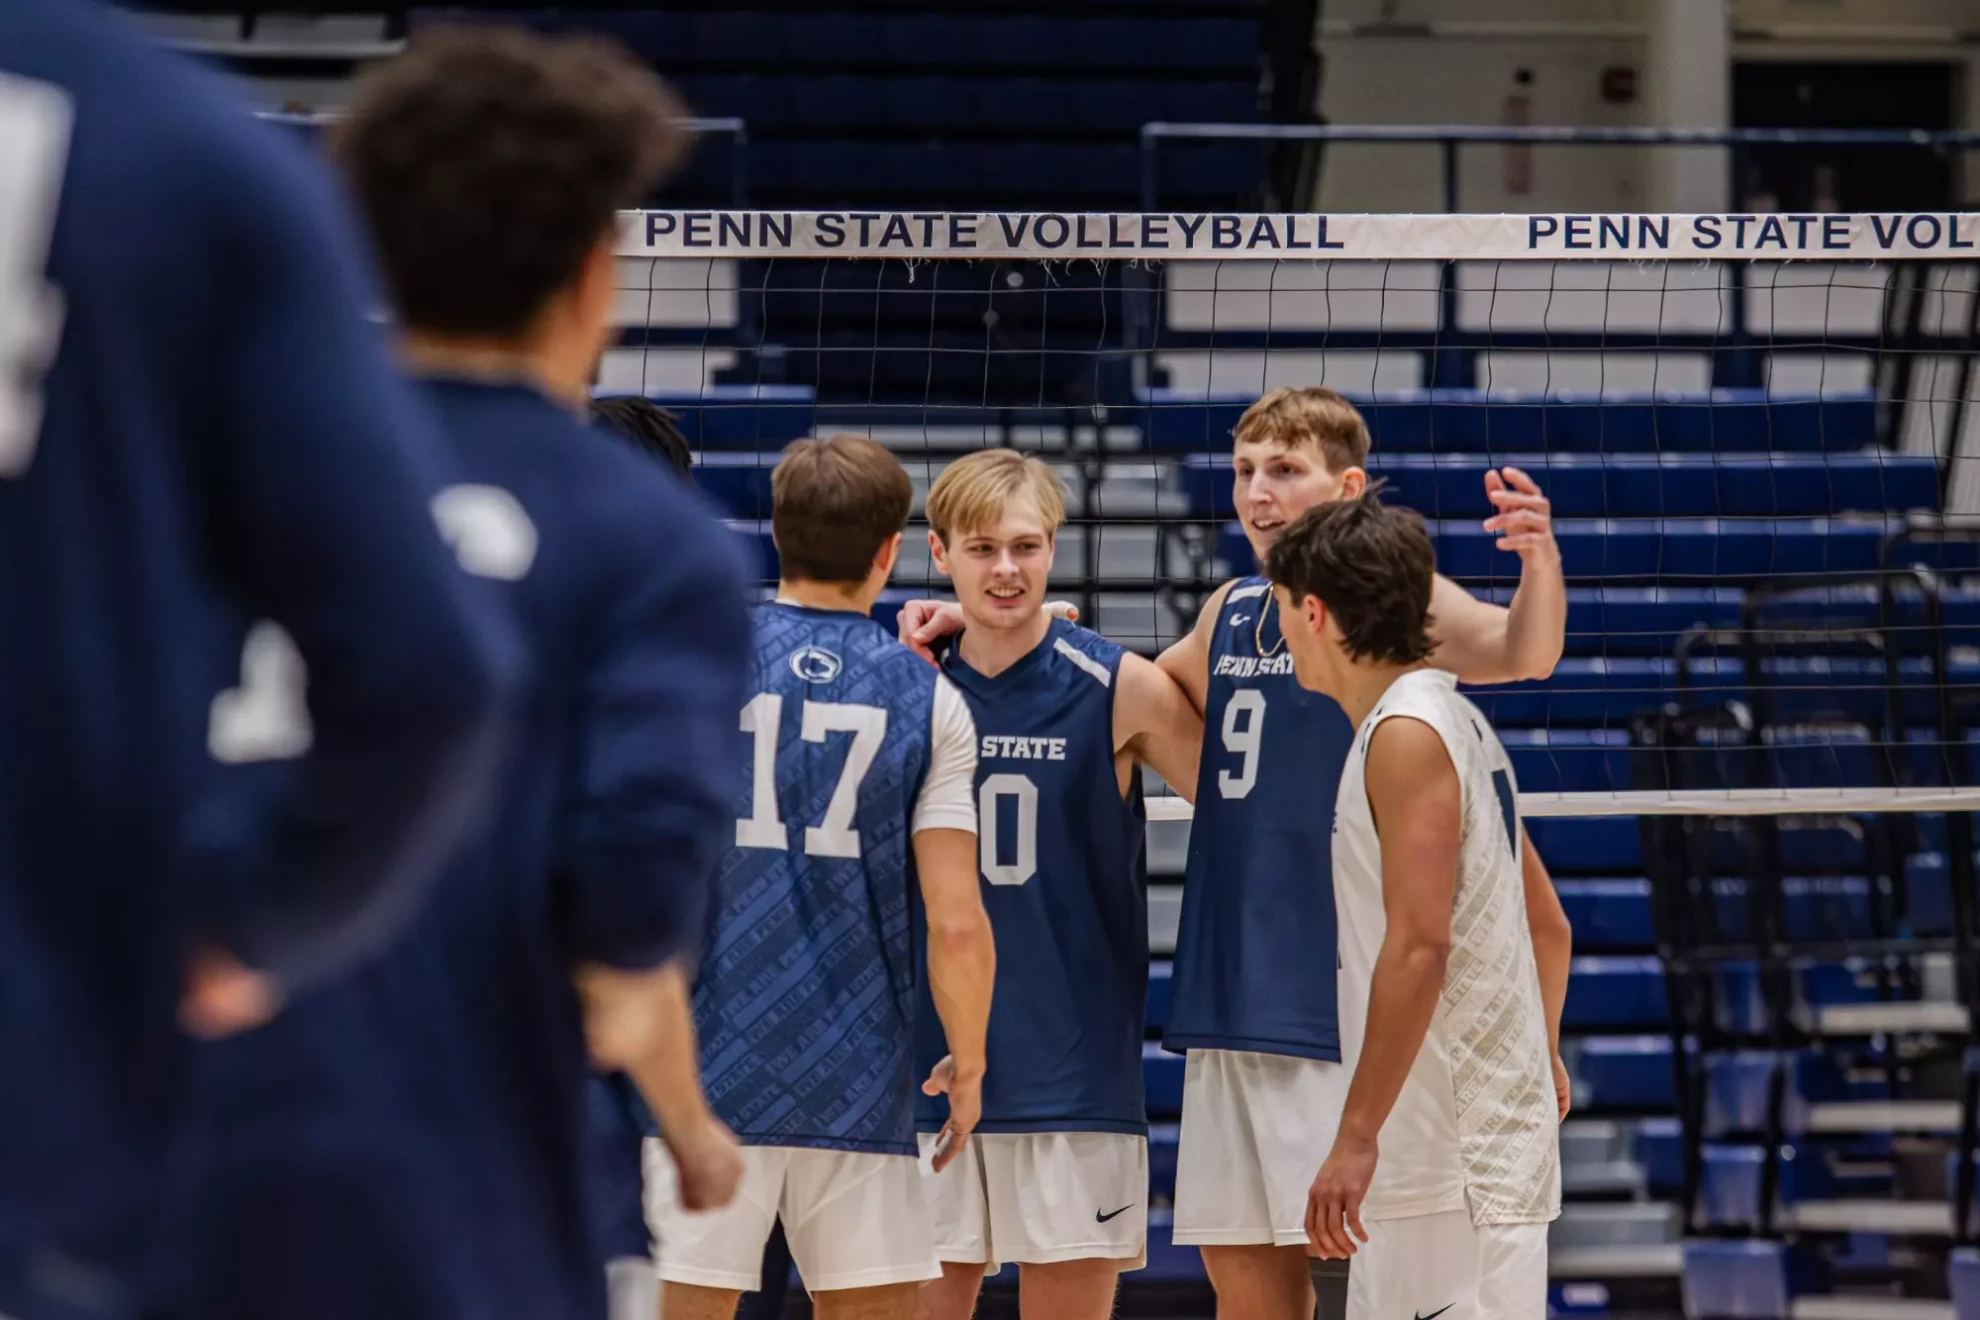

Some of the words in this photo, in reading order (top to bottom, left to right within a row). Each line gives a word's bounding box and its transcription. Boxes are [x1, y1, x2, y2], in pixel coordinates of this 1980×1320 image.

[645, 213, 792, 248] PENN
[813, 213, 978, 249] STATE
[997, 214, 1345, 249] VOLLEYBALL
[1528, 215, 1669, 250] PENN
[1691, 215, 1852, 250] STATE
[735, 692, 888, 859] 17
[980, 735, 1067, 761] STATE
[1218, 689, 1267, 799] 9
[979, 773, 1039, 886] 0
